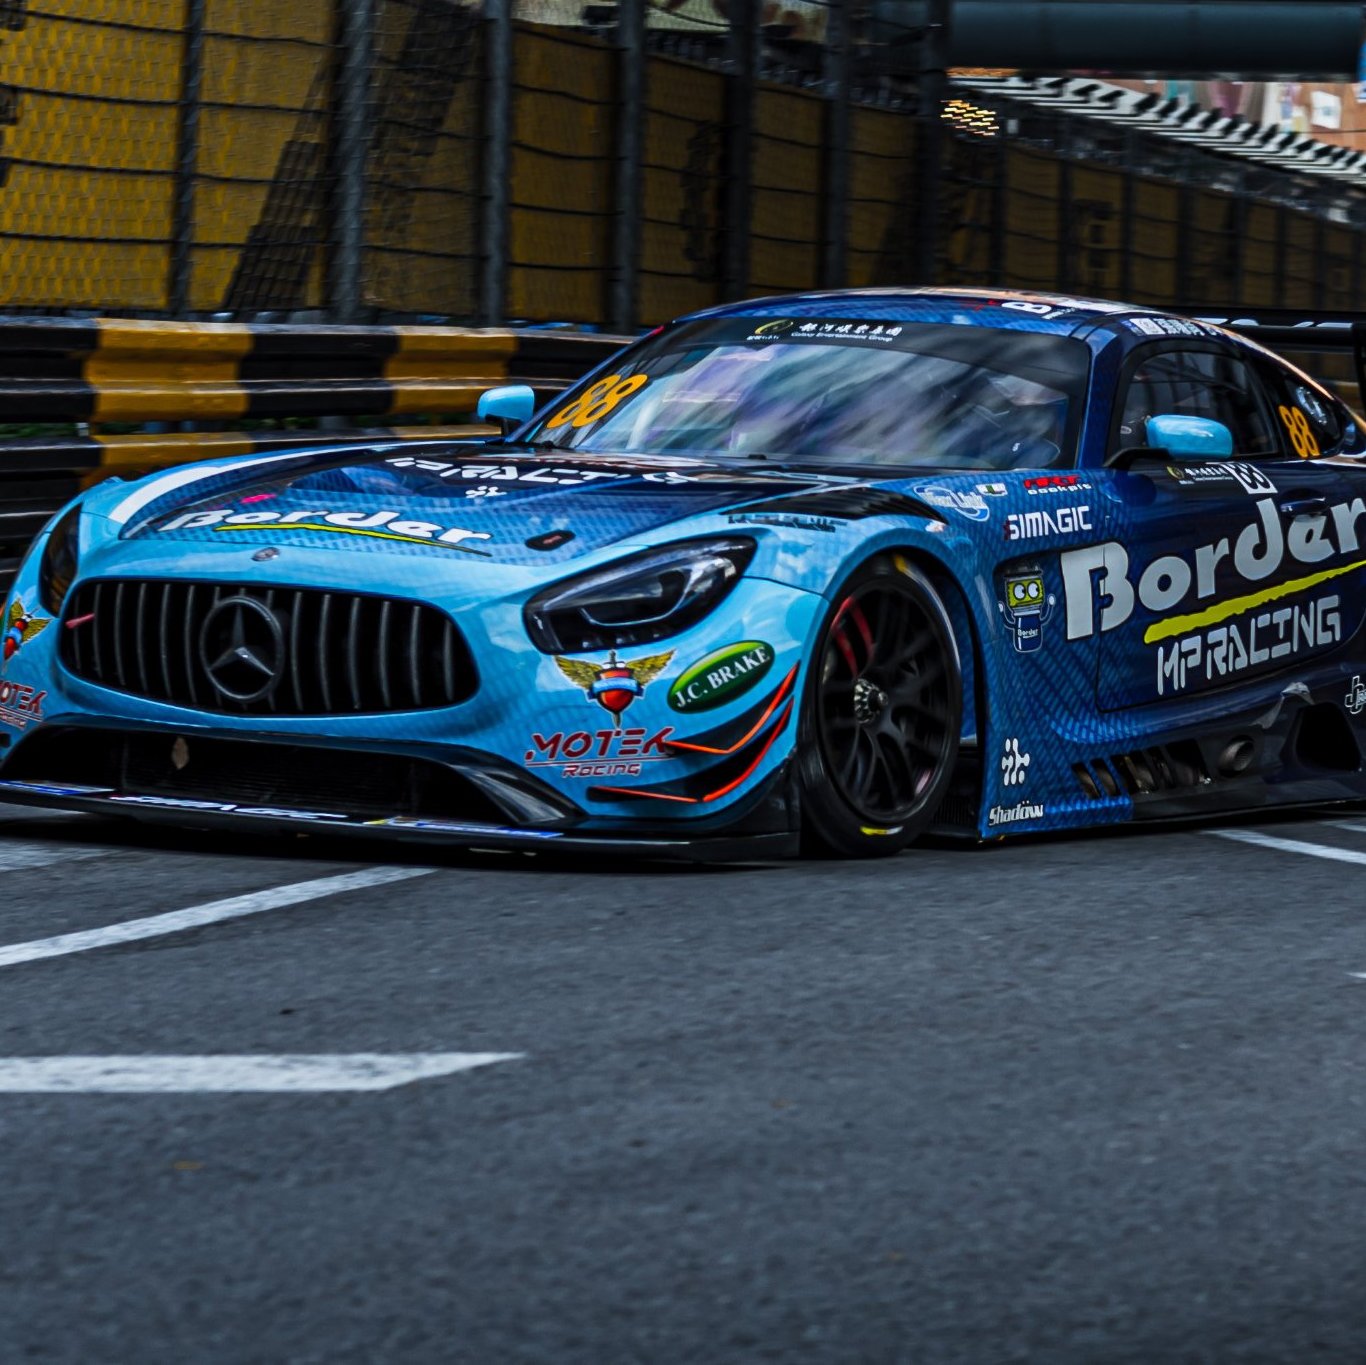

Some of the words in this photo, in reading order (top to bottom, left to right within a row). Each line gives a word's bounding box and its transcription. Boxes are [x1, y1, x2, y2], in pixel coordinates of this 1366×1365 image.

[546, 374, 648, 428] 88
[1278, 405, 1320, 458] 88
[157, 509, 492, 544] Border
[1006, 505, 1092, 540] SIMAGIC
[673, 681, 708, 709] J.C.
[707, 645, 771, 690] BRAKE
[524, 727, 675, 761] MOTEK
